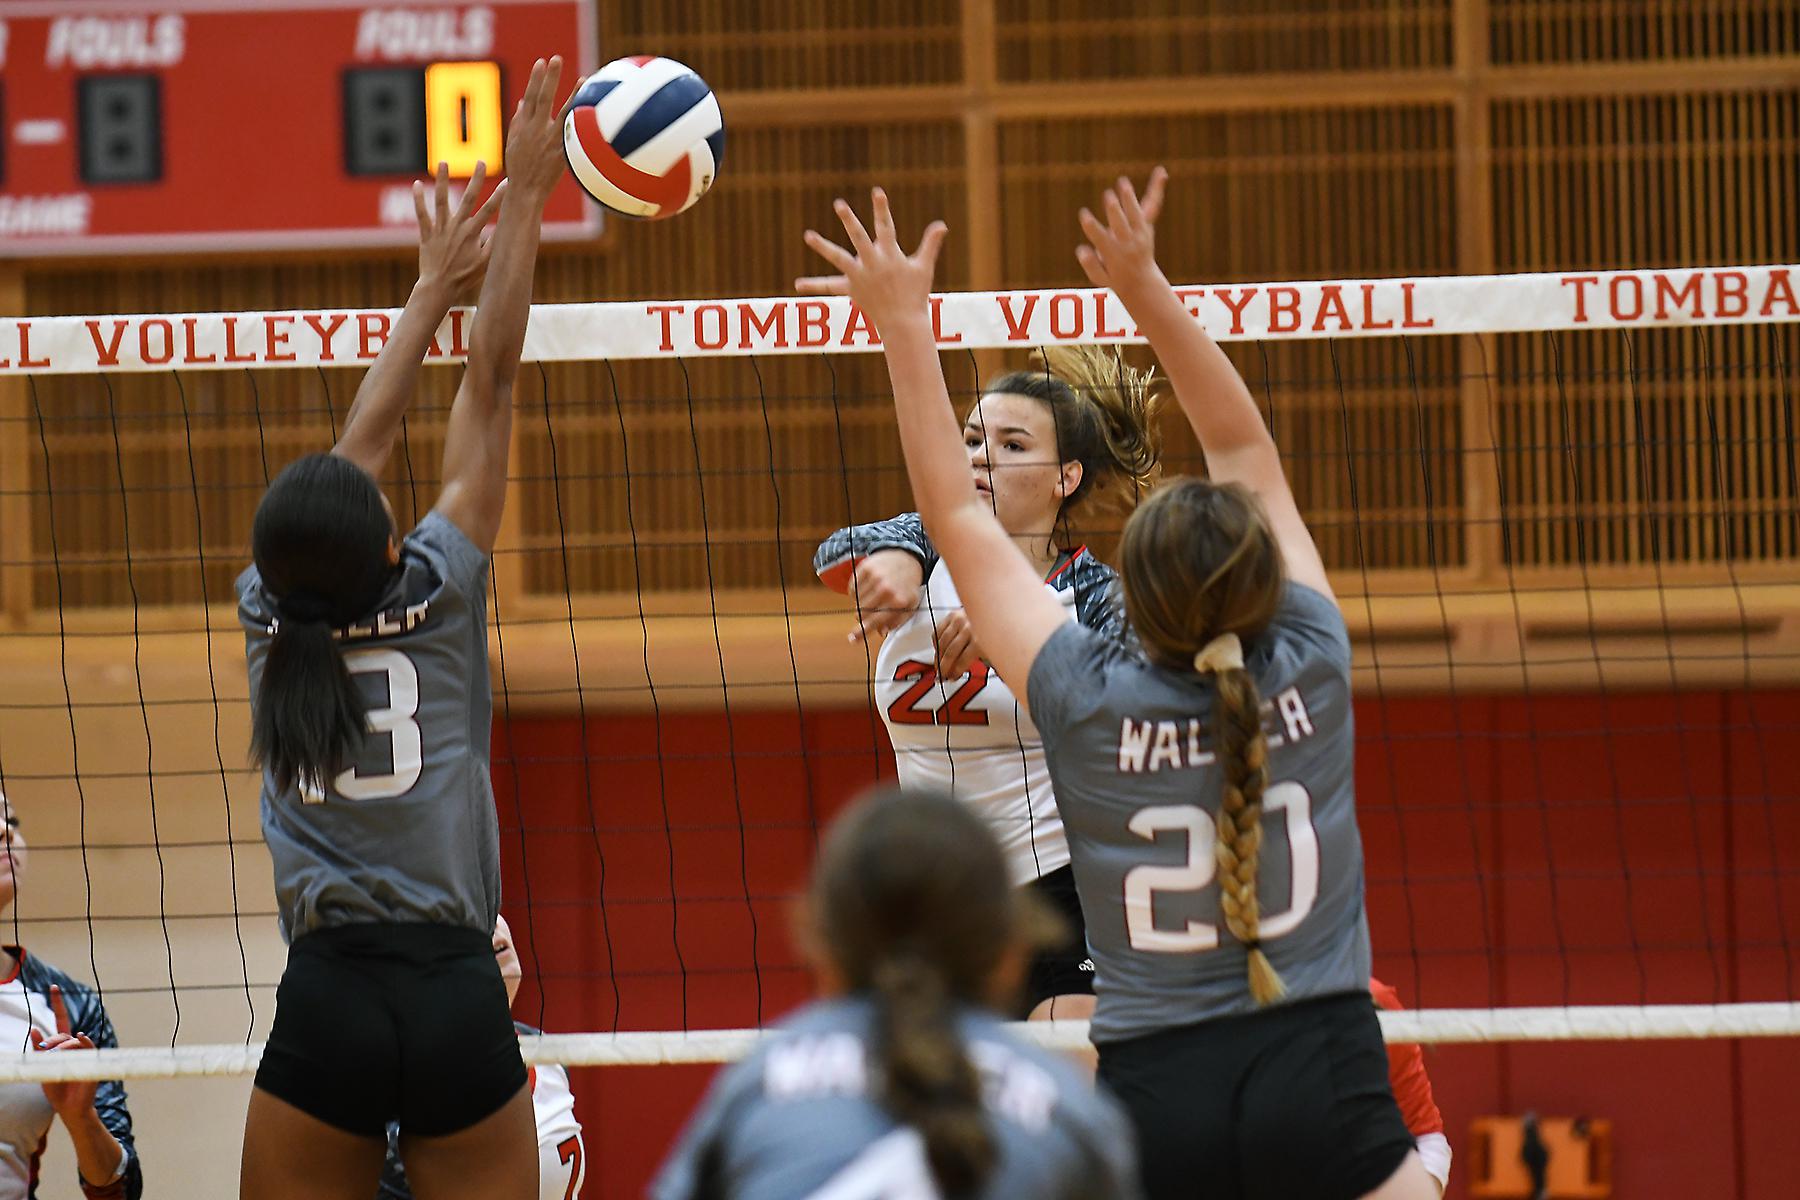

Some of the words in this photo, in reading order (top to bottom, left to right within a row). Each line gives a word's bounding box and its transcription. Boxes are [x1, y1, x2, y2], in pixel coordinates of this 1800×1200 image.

[46, 14, 187, 69] FOULS
[354, 8, 496, 61] FOULS
[425, 61, 504, 178] 0
[646, 297, 963, 351] TOMBAL
[995, 282, 1434, 341] VOLYBALL
[1560, 269, 1800, 323] TOMBA
[299, 648, 423, 803] 3
[886, 658, 990, 726] 22
[1118, 685, 1315, 773] WALER
[1124, 780, 1320, 953] 20
